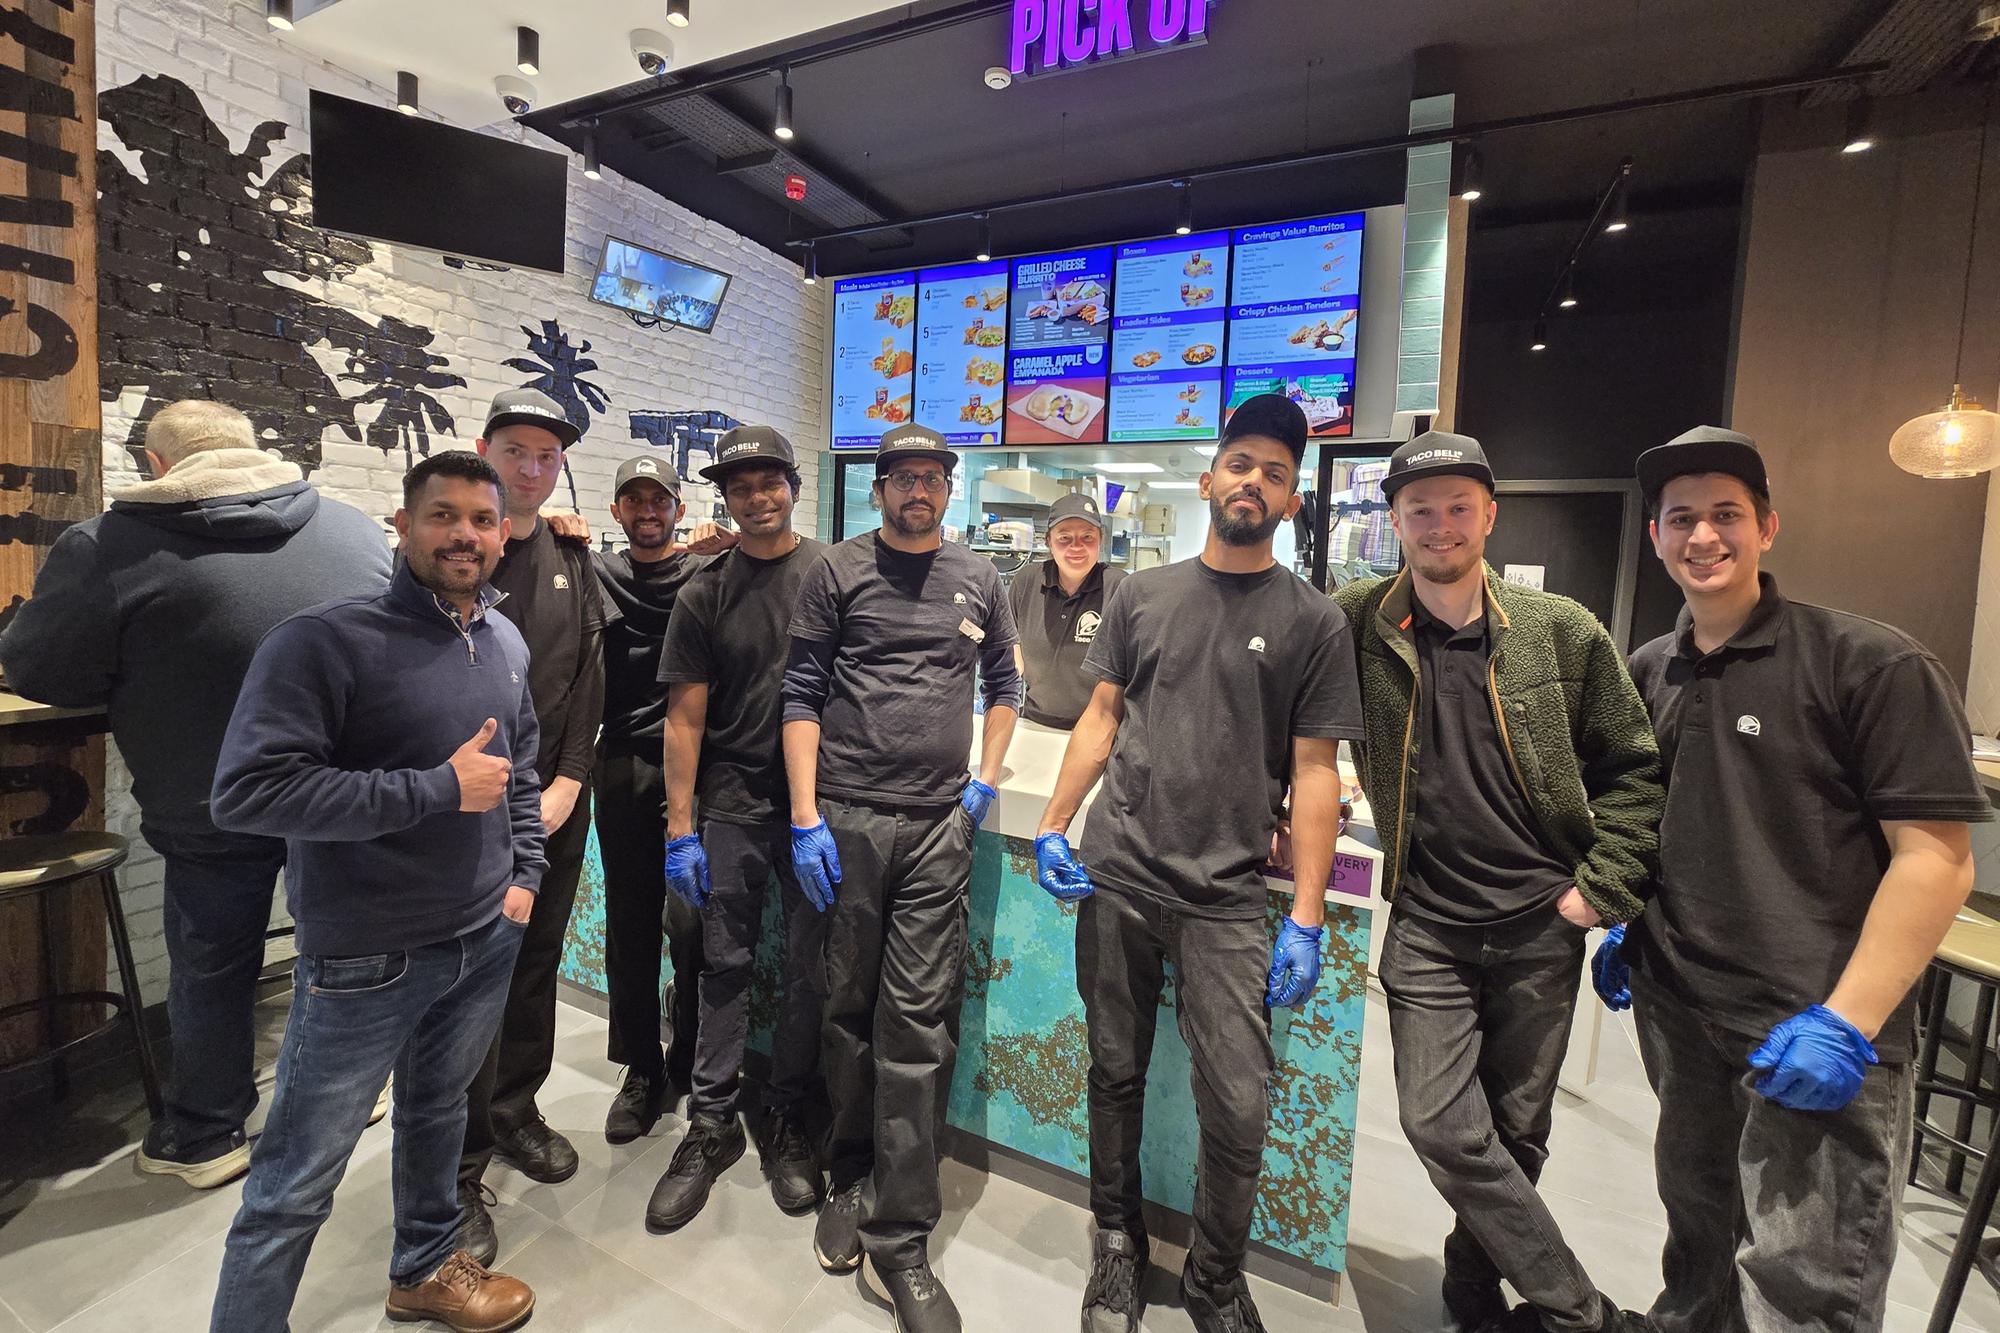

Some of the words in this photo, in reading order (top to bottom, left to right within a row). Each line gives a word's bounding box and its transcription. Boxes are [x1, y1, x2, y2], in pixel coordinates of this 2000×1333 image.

[1010, 0, 1133, 74] PICK
[1243, 231, 1281, 242] Cravings
[1282, 227, 1307, 238] Value
[1308, 222, 1346, 233] Burritos
[1017, 262, 1053, 277] GRILLED
[1053, 257, 1086, 273] CHEESE
[1017, 272, 1056, 286] BURRITO
[924, 289, 931, 302] 4
[841, 302, 845, 314] 1
[1238, 306, 1267, 318] Crispy
[1267, 303, 1304, 315] Chicken
[1304, 300, 1341, 312] Tenders
[1120, 317, 1149, 328] Loaded
[1149, 316, 1172, 325] Sides
[923, 326, 930, 340] 5
[839, 346, 846, 359] 2
[1013, 355, 1055, 371] CARAMEL
[1055, 353, 1084, 367] APPLE
[921, 363, 928, 376] 6
[1013, 366, 1065, 378] EMPANADA
[1235, 367, 1274, 377] Desserts
[1118, 374, 1160, 385] Vegetarian
[838, 395, 844, 408] 3
[920, 399, 927, 412] 7
[509, 404, 535, 414] TACO
[893, 437, 915, 448] TACO
[721, 445, 738, 459] TACO
[737, 442, 758, 452] BELL
[1405, 451, 1434, 466] TACO
[1433, 449, 1461, 458] BELL
[1335, 856, 1369, 871] VERY
